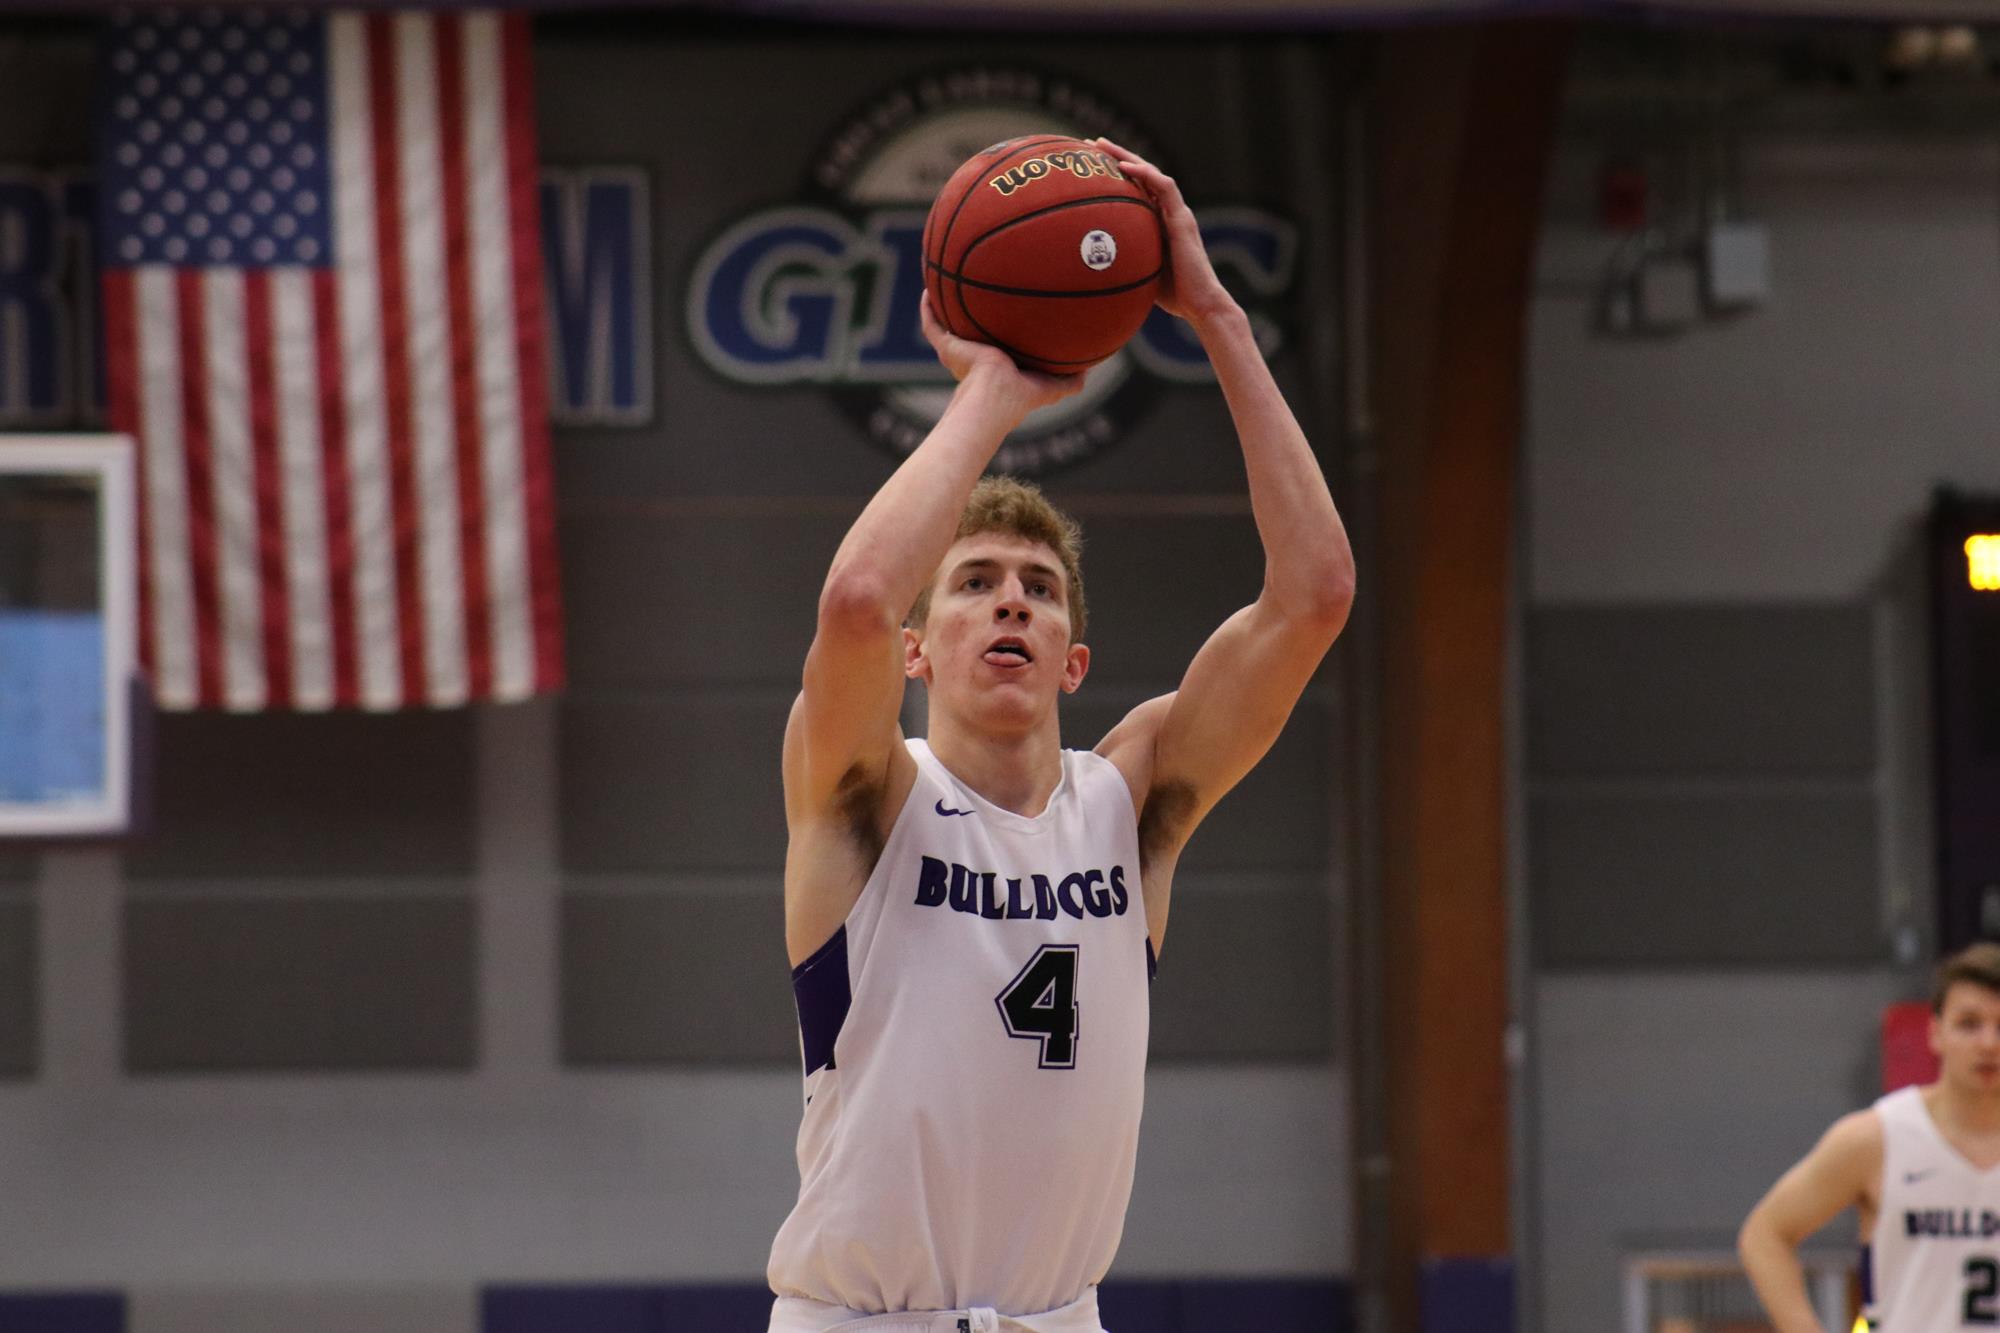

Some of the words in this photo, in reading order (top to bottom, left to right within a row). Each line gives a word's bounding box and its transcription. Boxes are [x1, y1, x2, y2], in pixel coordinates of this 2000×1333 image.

[914, 855, 1129, 921] BULLDOGS
[994, 943, 1080, 1070] 4
[1962, 1256, 2000, 1325] 2
